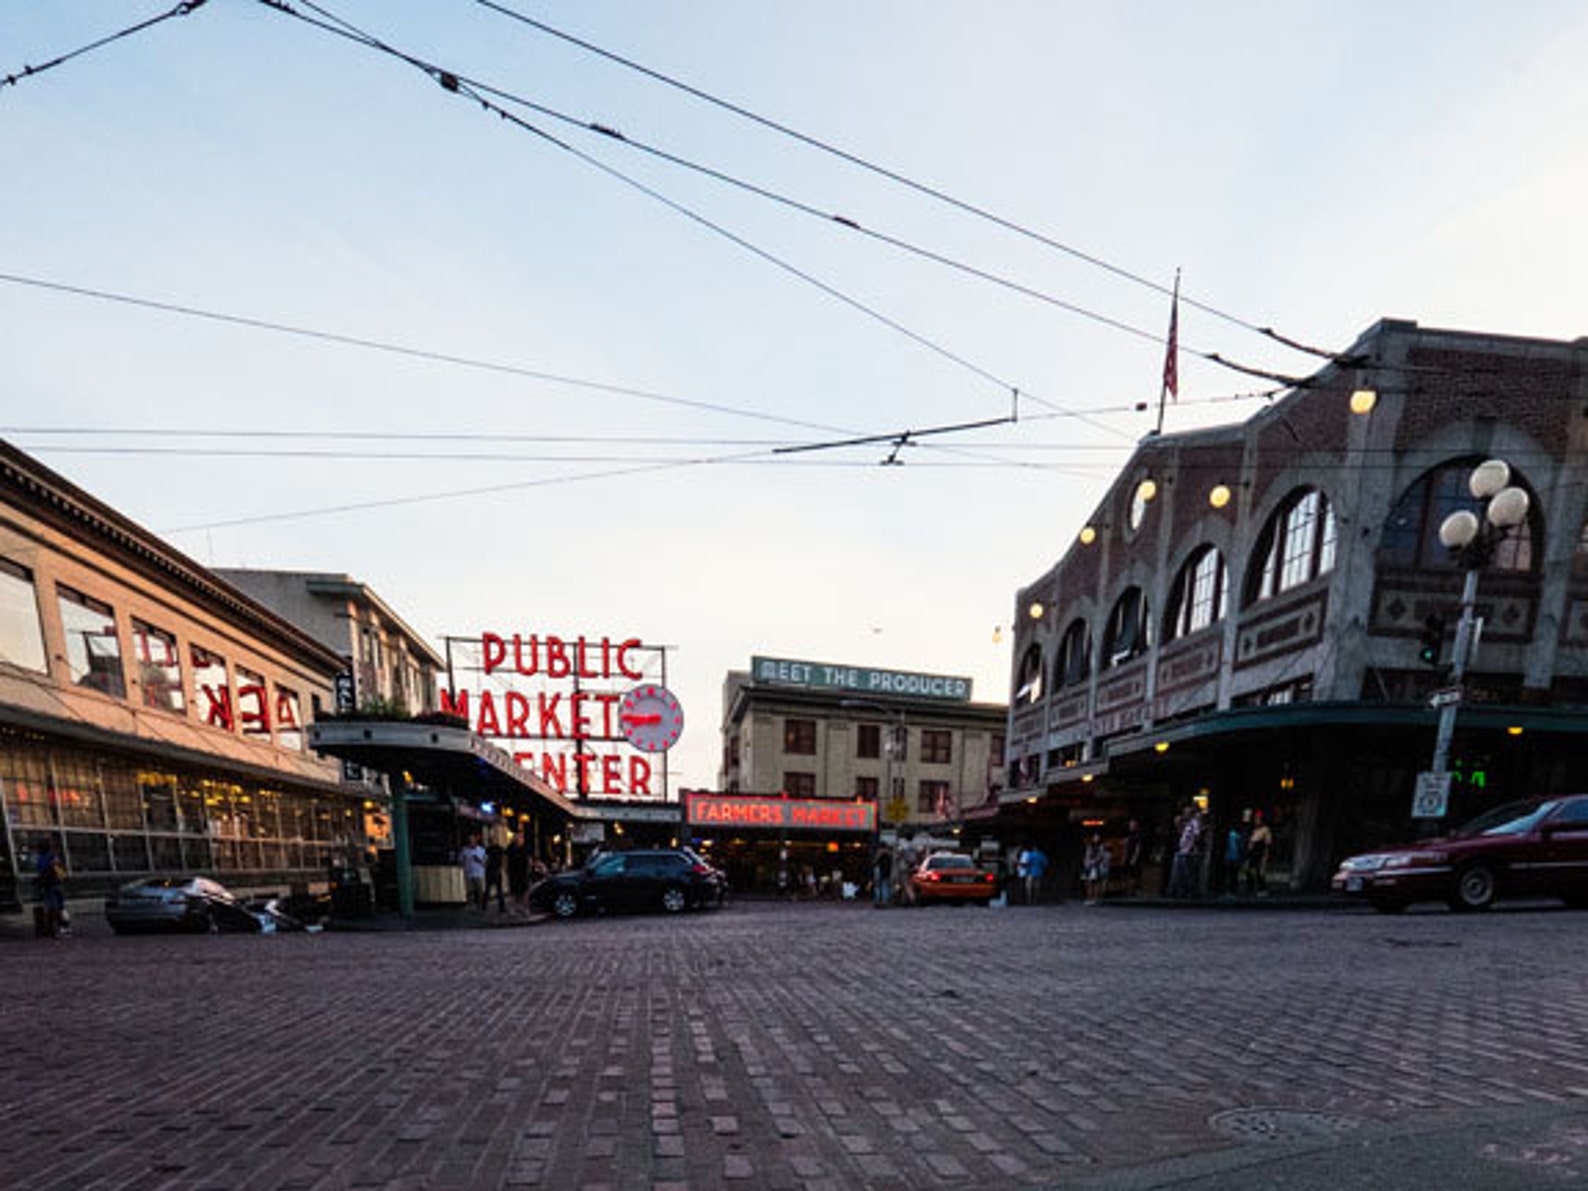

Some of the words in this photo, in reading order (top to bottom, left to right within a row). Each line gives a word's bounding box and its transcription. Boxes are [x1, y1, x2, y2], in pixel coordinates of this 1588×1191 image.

[482, 632, 643, 680] PUBLIC
[760, 661, 811, 682] MEET
[823, 667, 858, 688] THE
[870, 672, 966, 695] PRODUCER
[440, 688, 622, 740] MARKET
[696, 802, 783, 823] FARMERS
[791, 806, 867, 827] MARKET
